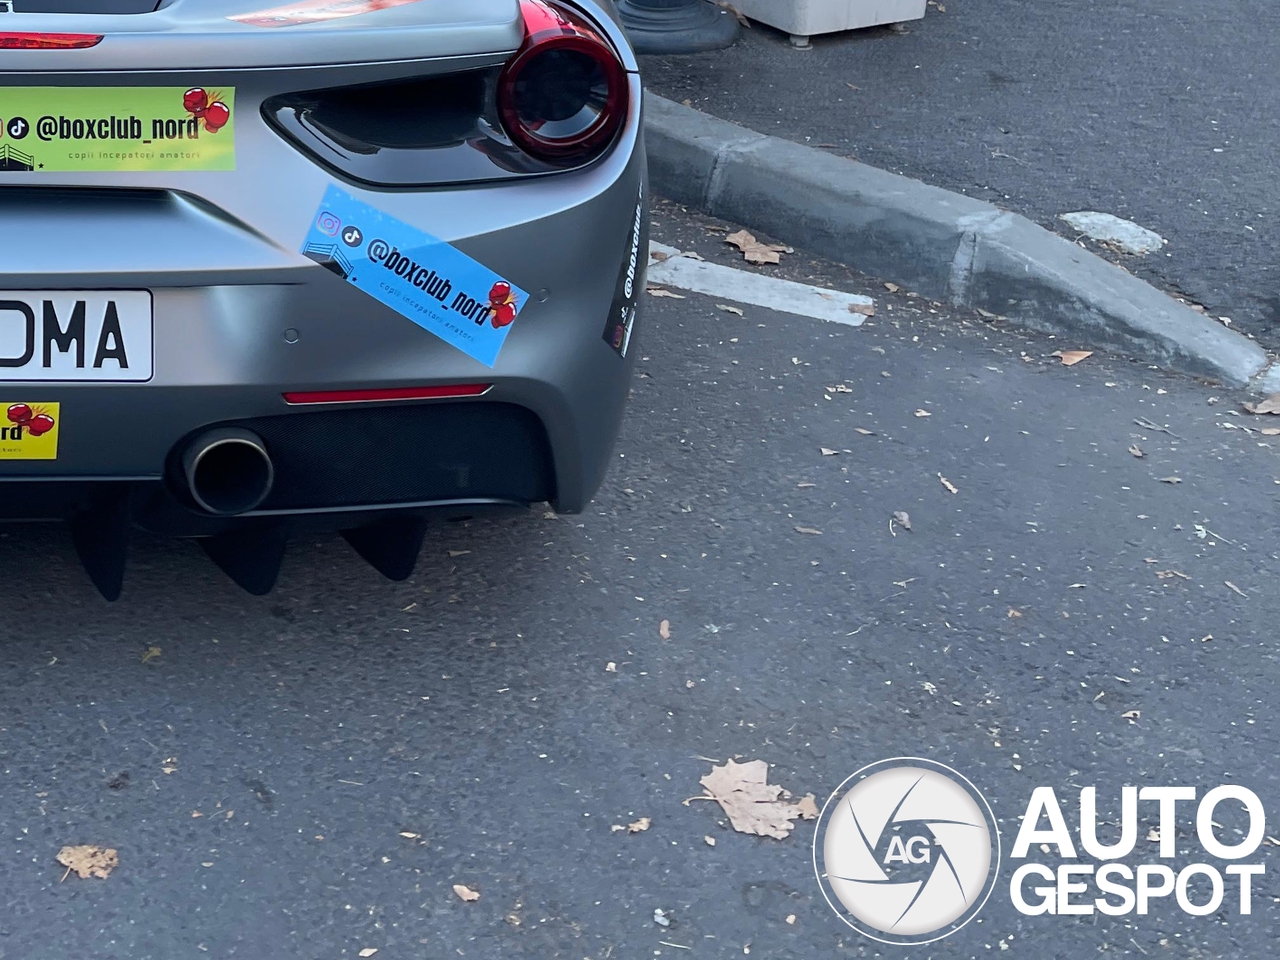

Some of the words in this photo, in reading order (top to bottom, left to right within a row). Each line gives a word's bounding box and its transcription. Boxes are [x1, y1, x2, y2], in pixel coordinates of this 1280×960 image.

[36, 115, 199, 144] @boxclub_nord
[68, 151, 94, 161] copii
[159, 151, 200, 159] amatori
[367, 238, 493, 327] @boxclub_nord
[444, 321, 475, 342] amatori
